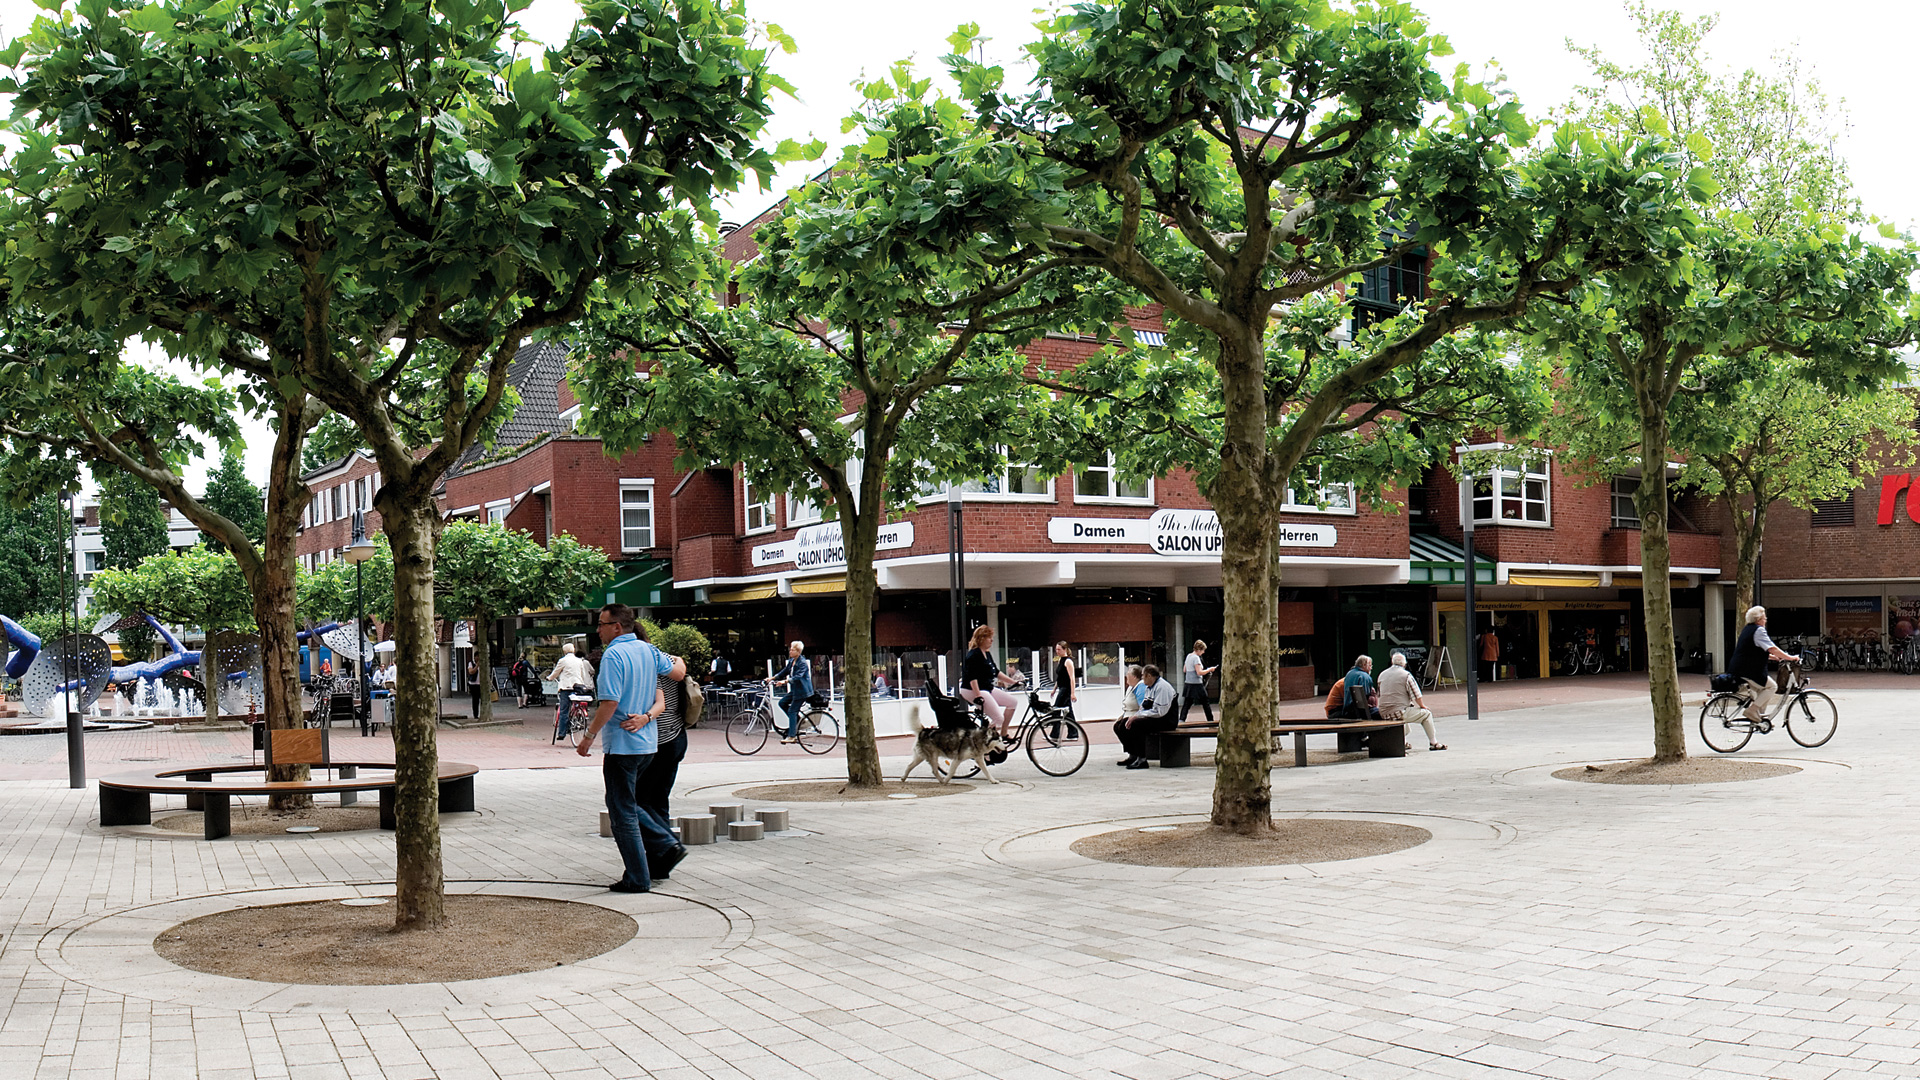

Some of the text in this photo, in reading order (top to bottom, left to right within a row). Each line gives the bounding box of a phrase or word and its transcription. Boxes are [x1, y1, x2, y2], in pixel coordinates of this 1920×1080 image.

[1158, 513, 1181, 531] Ihr
[1074, 523, 1125, 538] Damen
[1279, 528, 1319, 541] Herren
[875, 532, 898, 545] erren
[1157, 535, 1202, 552] SALON
[761, 548, 785, 561] Damen
[797, 546, 846, 567] SALON UPHO
